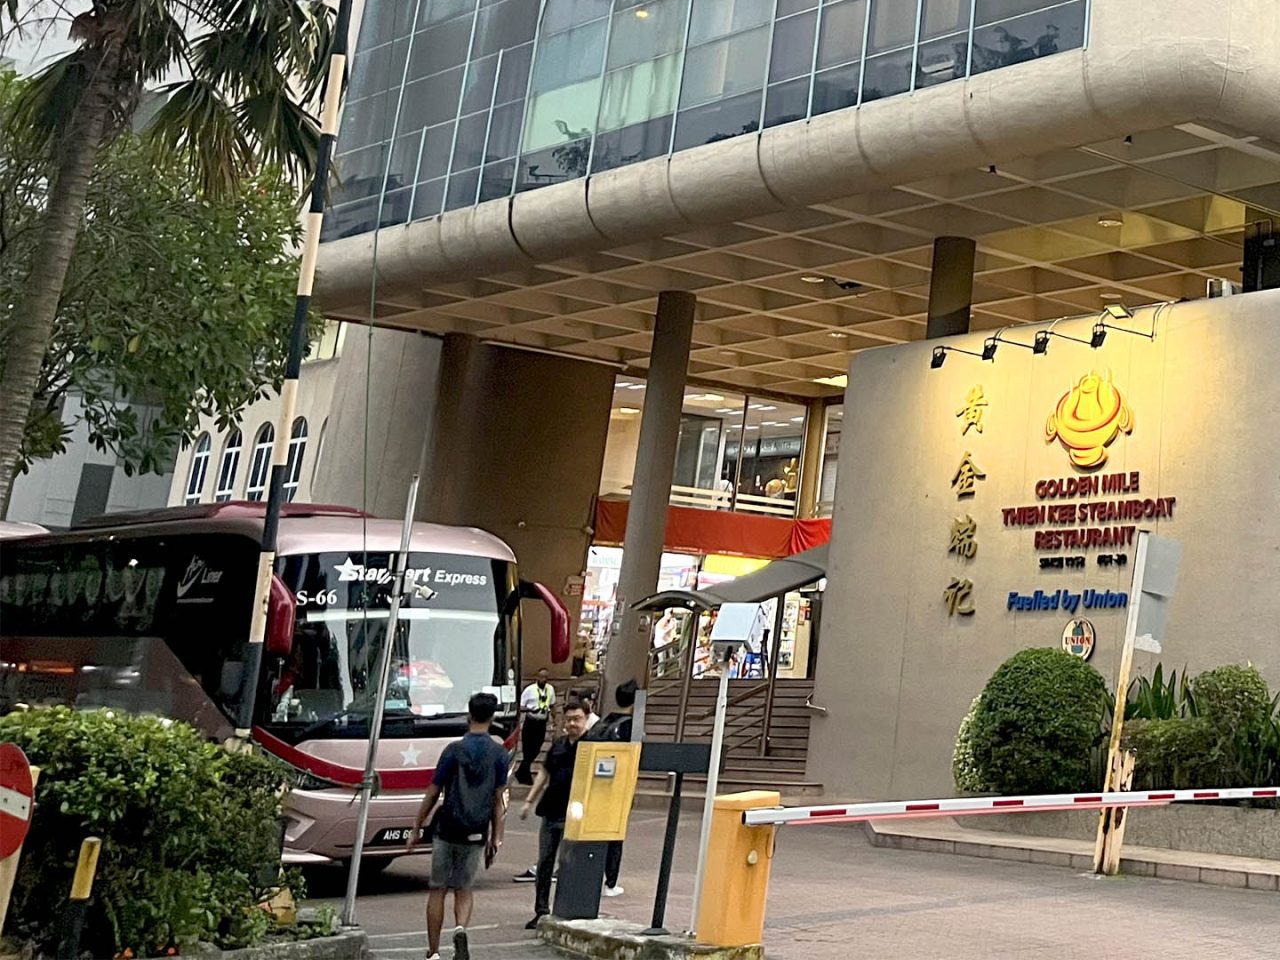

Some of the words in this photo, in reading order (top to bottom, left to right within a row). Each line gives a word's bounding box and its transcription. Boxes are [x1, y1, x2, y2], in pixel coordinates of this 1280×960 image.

[1035, 475, 1099, 498] GOLDEN
[1102, 471, 1140, 494] MILE
[1001, 505, 1046, 526] THIEN
[1048, 503, 1076, 524] KEE
[1078, 497, 1176, 522] STEAMBOAT
[1034, 526, 1136, 550] RESTAURANT
[434, 570, 487, 586] Express
[296, 589, 337, 607] S-66
[1007, 589, 1061, 611] Fuelled
[1062, 589, 1081, 614] by
[1083, 589, 1128, 609] Union
[1065, 636, 1092, 646] UNION
[383, 830, 400, 840] AHS
